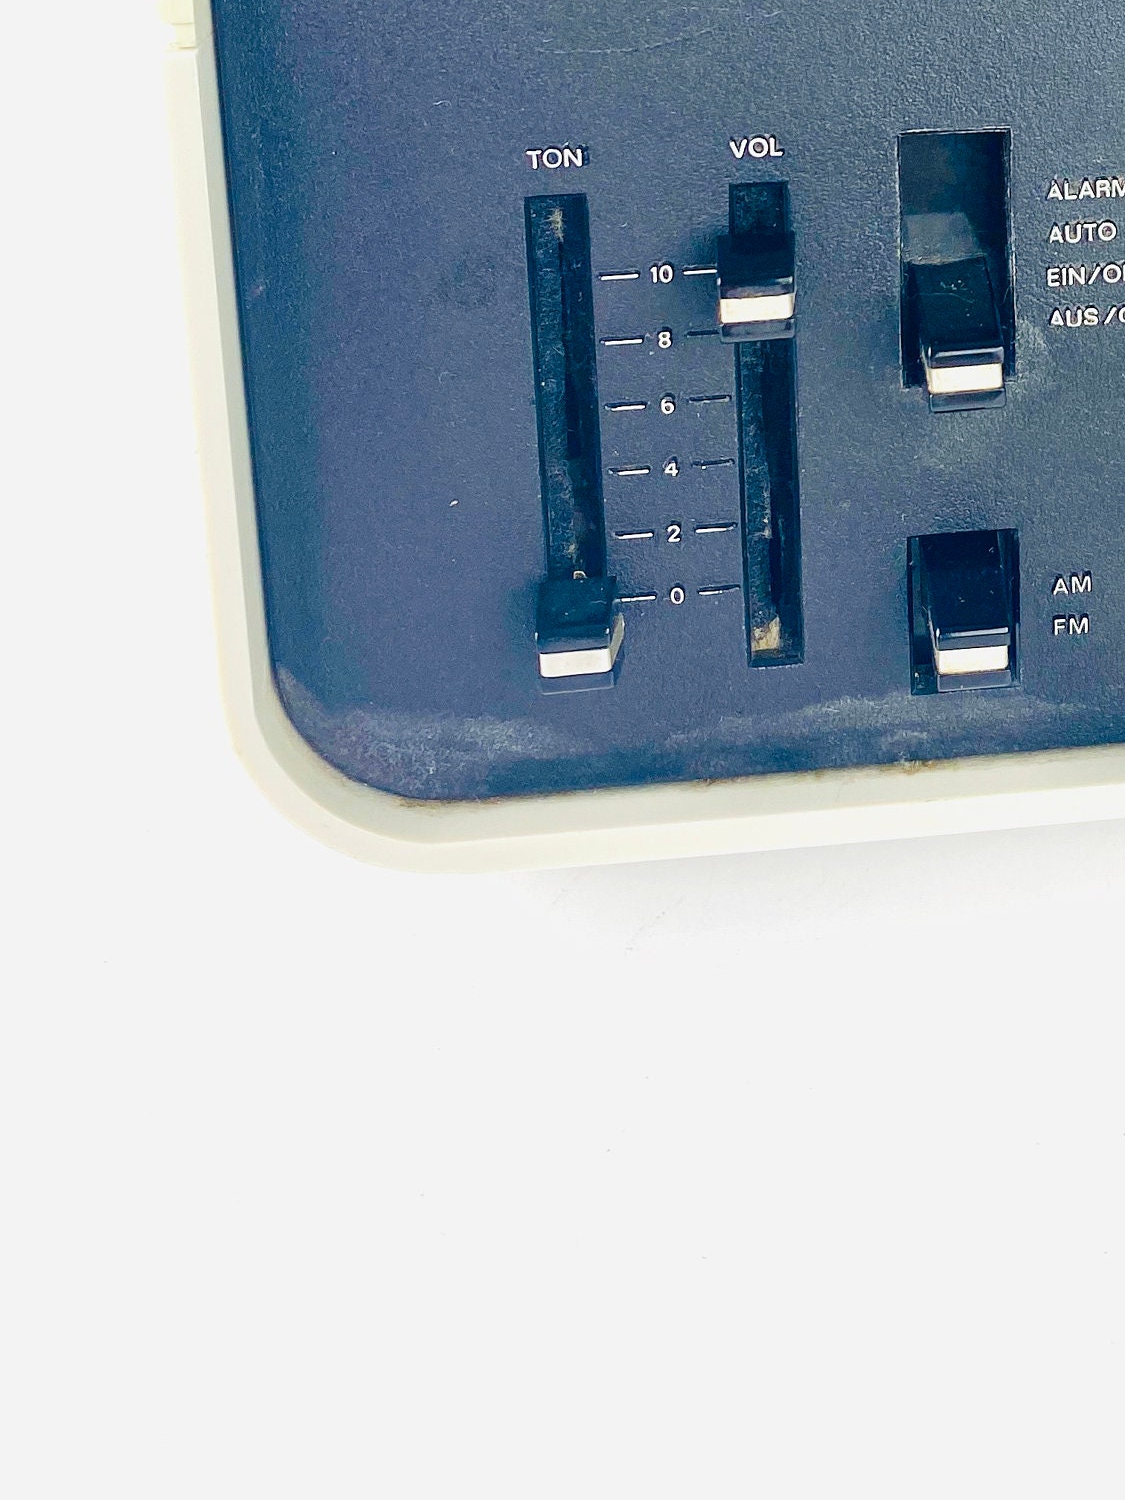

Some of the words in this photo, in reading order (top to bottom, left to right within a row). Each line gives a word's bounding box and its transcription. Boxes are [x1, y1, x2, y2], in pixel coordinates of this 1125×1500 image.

[729, 134, 783, 158] VOL
[526, 148, 583, 169] TON
[1049, 221, 1117, 244] AUTO
[649, 265, 673, 284] 10
[657, 331, 672, 350] 8
[660, 396, 675, 415] 6
[663, 460, 679, 477] 4
[667, 525, 681, 543] 2
[1053, 575, 1092, 596] AM
[670, 587, 684, 605] 0
[1054, 617, 1089, 636] FM
